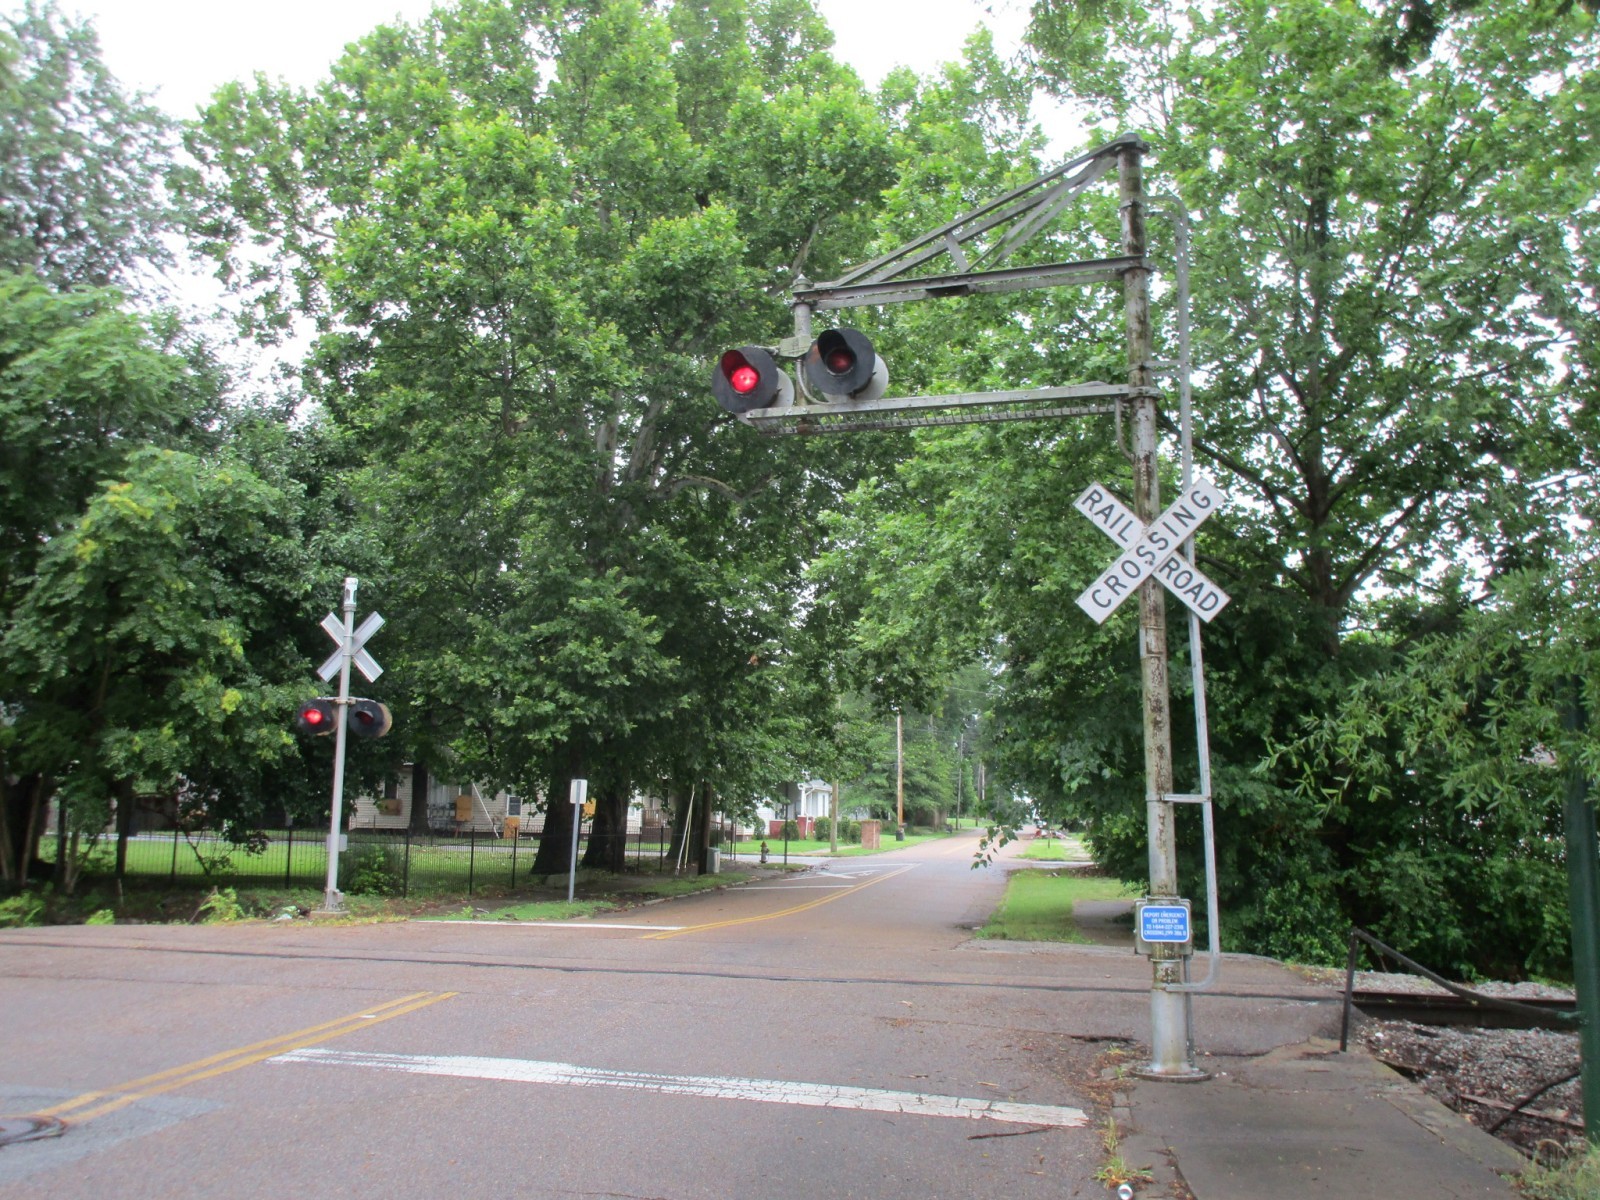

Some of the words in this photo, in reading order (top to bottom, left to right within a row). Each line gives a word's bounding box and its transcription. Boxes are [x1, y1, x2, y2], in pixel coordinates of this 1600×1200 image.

[1081, 489, 1133, 543] RAIL
[1159, 557, 1219, 612] ROAD
[1091, 490, 1211, 609] CROSSING
